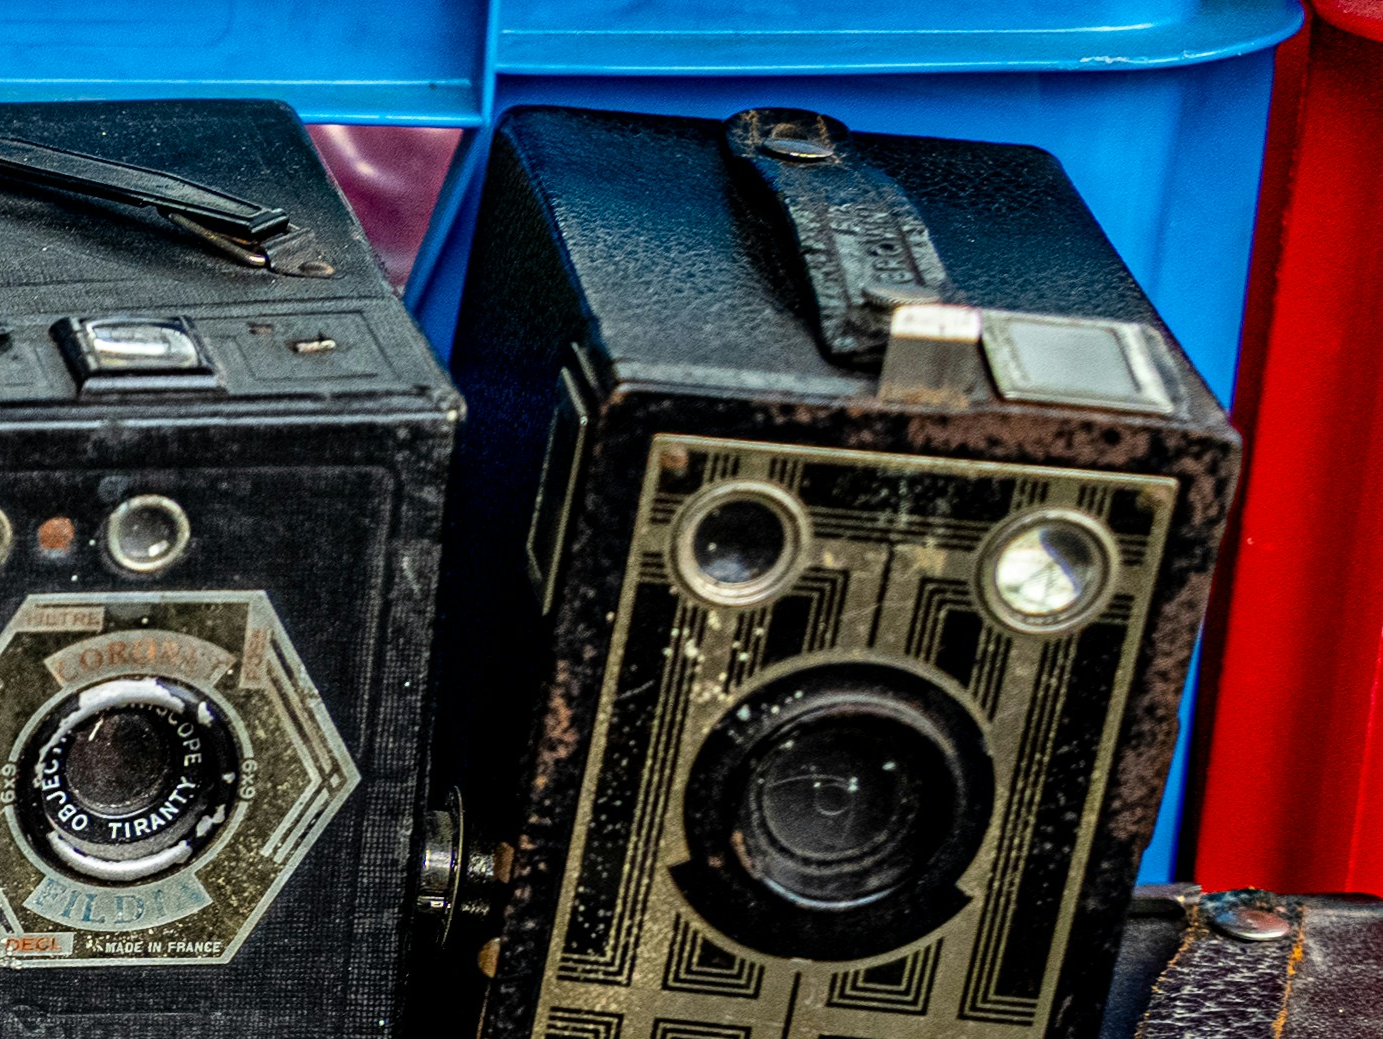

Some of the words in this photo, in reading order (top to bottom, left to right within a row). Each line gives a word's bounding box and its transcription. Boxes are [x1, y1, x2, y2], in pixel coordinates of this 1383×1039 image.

[108, 775, 197, 839] TIRANTY
[105, 942, 145, 953] MADE
[148, 942, 162, 953] IN
[167, 941, 222, 953] FRANCE
